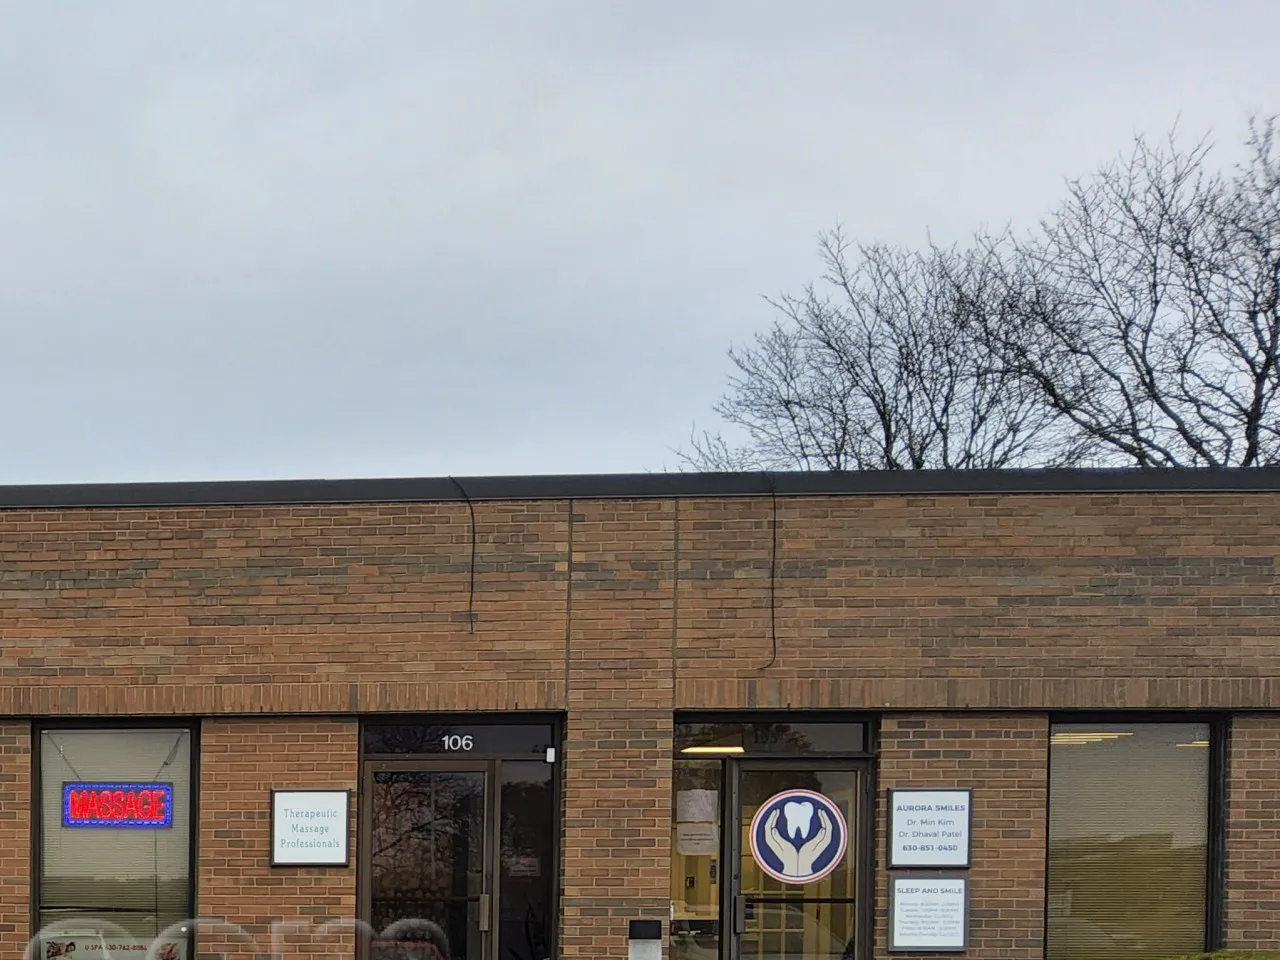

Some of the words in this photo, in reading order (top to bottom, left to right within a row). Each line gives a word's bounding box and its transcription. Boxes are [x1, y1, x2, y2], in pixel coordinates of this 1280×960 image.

[441, 735, 473, 750] 106
[69, 789, 165, 820] MASSAGE
[896, 804, 933, 812] AURORA
[935, 804, 966, 812] SMILES
[283, 808, 338, 820] Therapeutic
[906, 818, 919, 827] Dr.
[920, 818, 936, 826] Min
[938, 818, 955, 826] Kim
[291, 823, 330, 836] Massage
[898, 830, 910, 838] Dr.
[912, 830, 940, 838] Dhaval
[941, 830, 963, 838] Patel
[280, 837, 341, 849] Professionals
